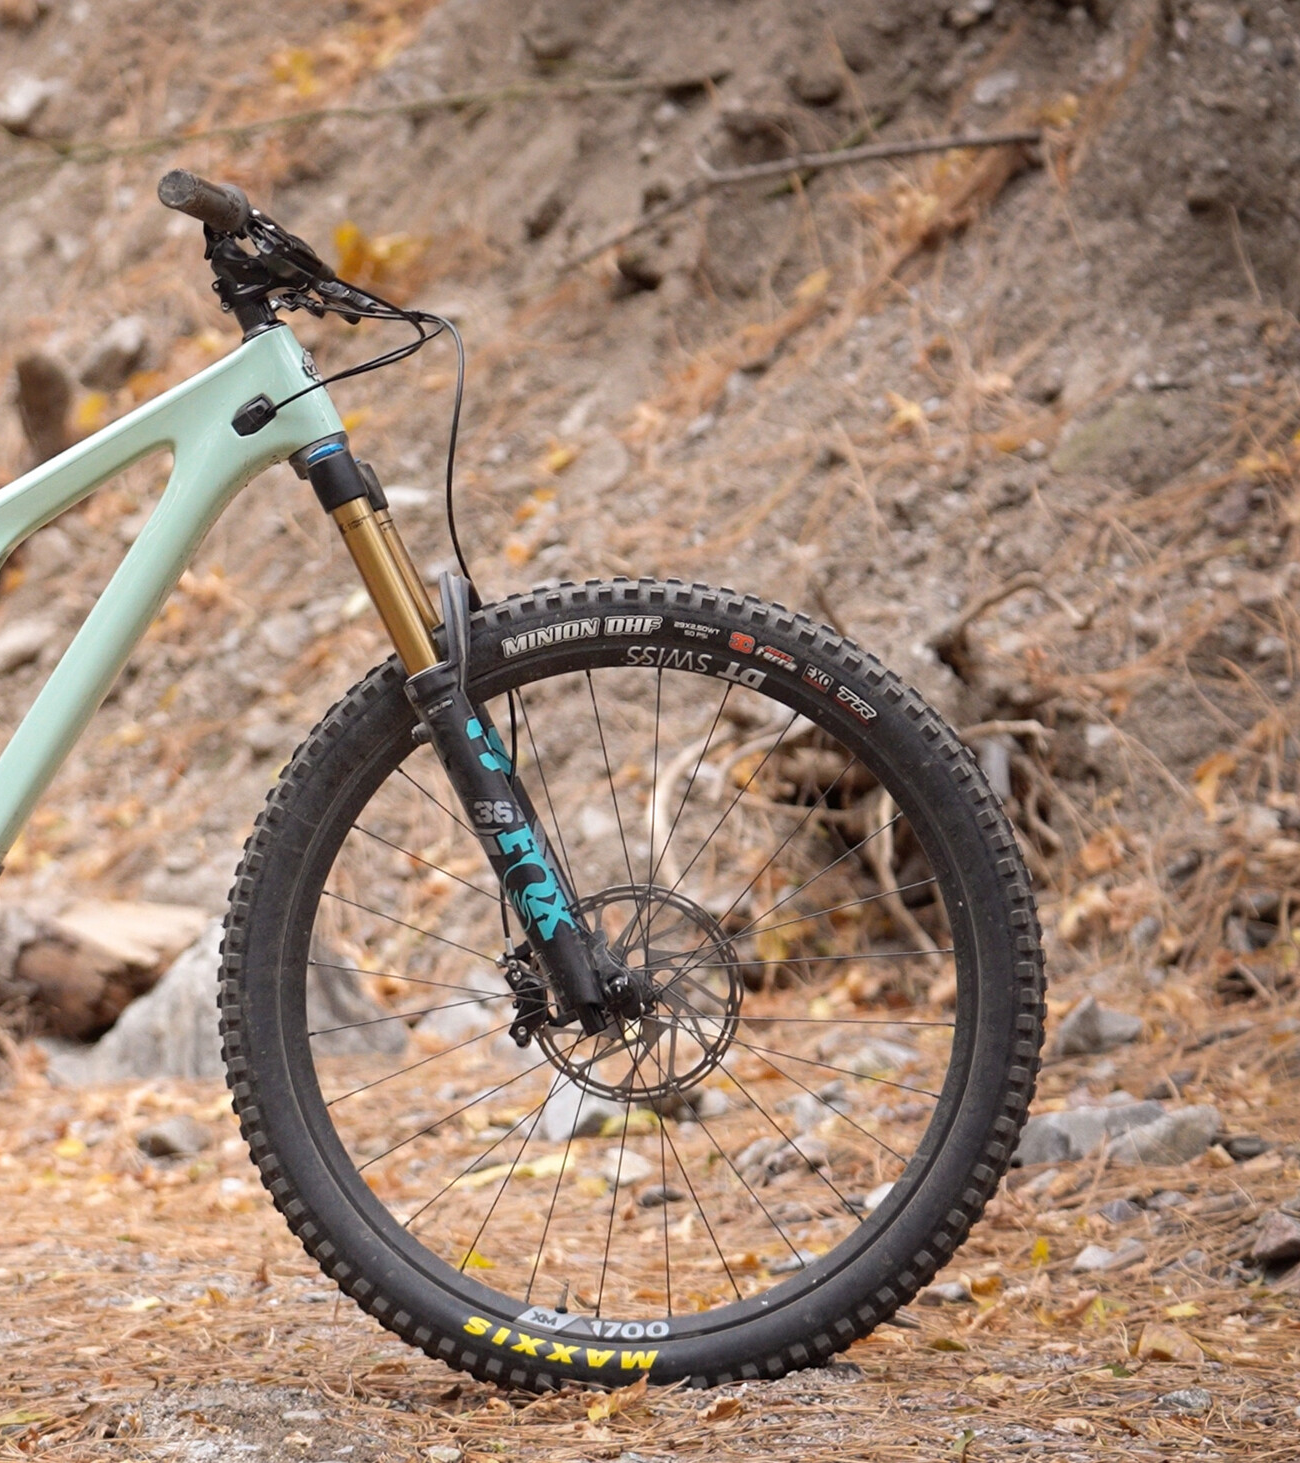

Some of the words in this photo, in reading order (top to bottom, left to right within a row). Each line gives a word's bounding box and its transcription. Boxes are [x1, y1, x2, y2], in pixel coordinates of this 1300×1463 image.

[501, 617, 600, 658] MINION
[604, 615, 663, 636] DHF
[626, 646, 712, 672] SWISS
[717, 661, 768, 690] DT
[804, 664, 833, 689] EXO
[837, 685, 877, 719] TR
[474, 800, 514, 823] 36
[497, 823, 579, 941] FOX
[531, 1311, 558, 1326] XM
[591, 1320, 670, 1339] 1700
[463, 1316, 659, 1369] MAXXIS
